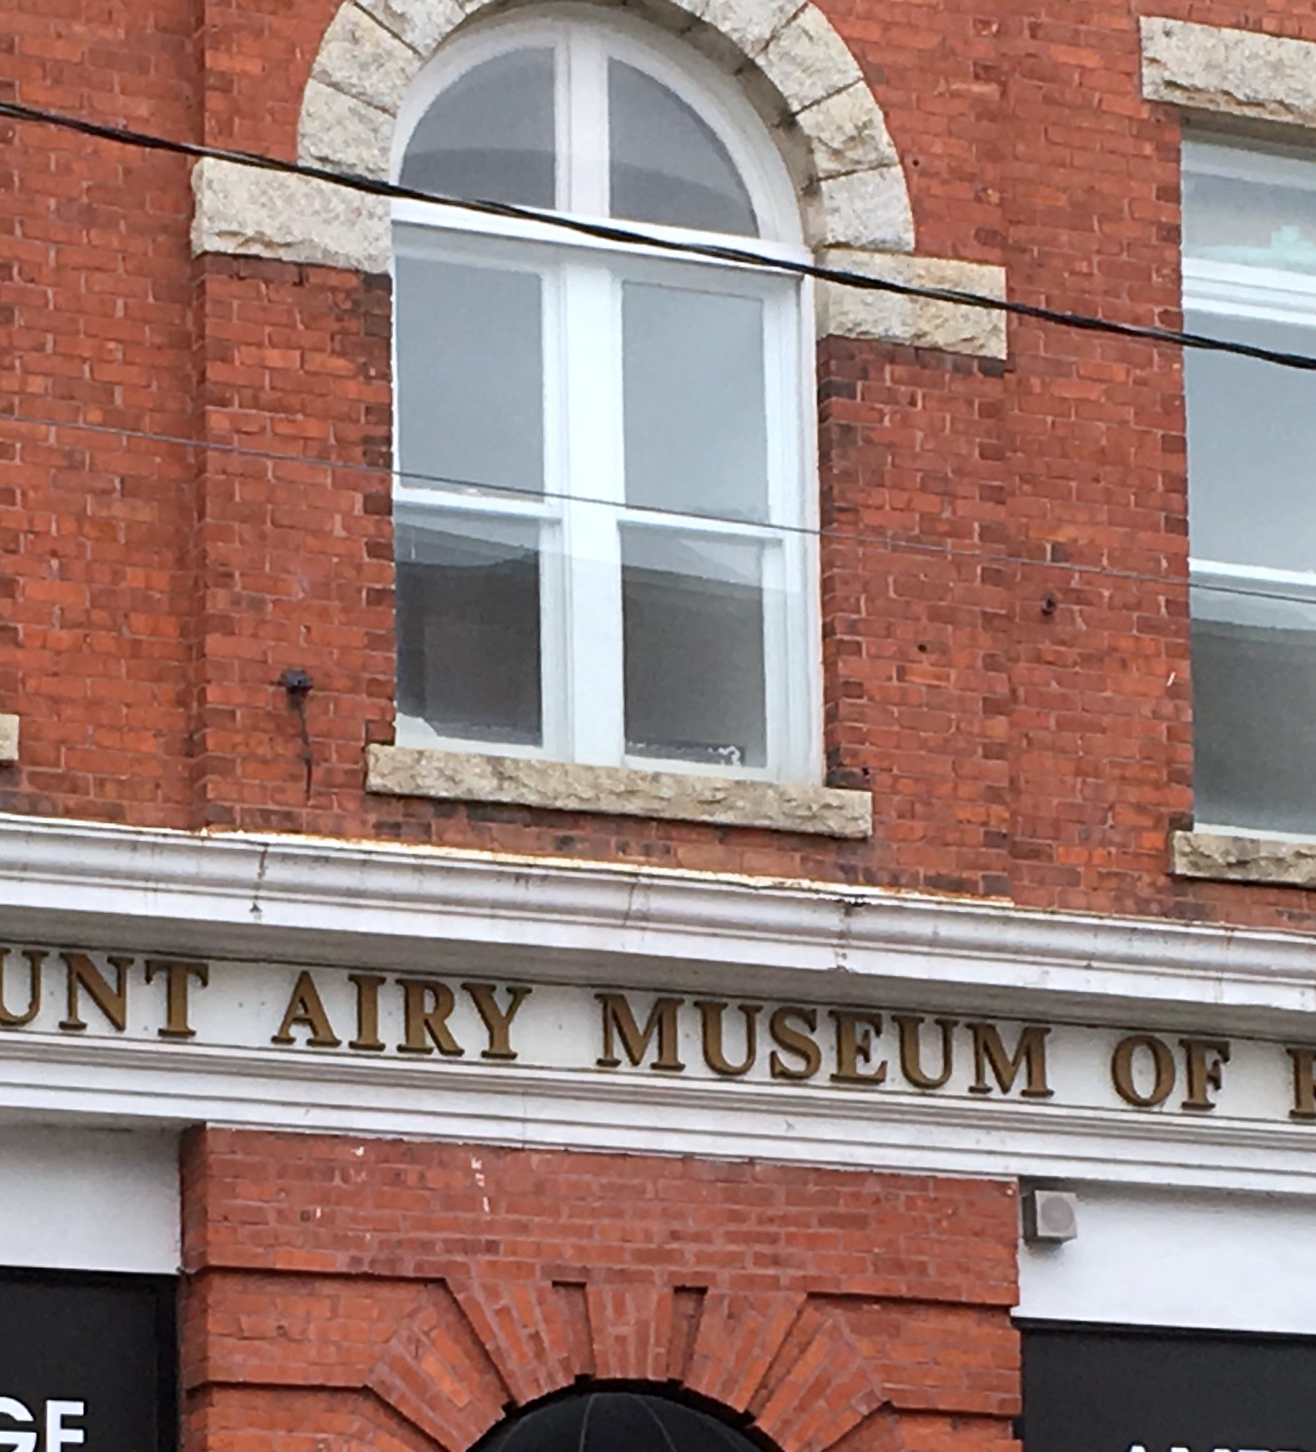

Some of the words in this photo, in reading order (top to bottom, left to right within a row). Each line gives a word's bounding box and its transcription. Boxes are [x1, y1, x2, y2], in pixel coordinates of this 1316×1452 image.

[272, 970, 532, 1059] AIRY
[594, 992, 1054, 1098] MUSEUM
[1110, 1034, 1232, 1110] OF
